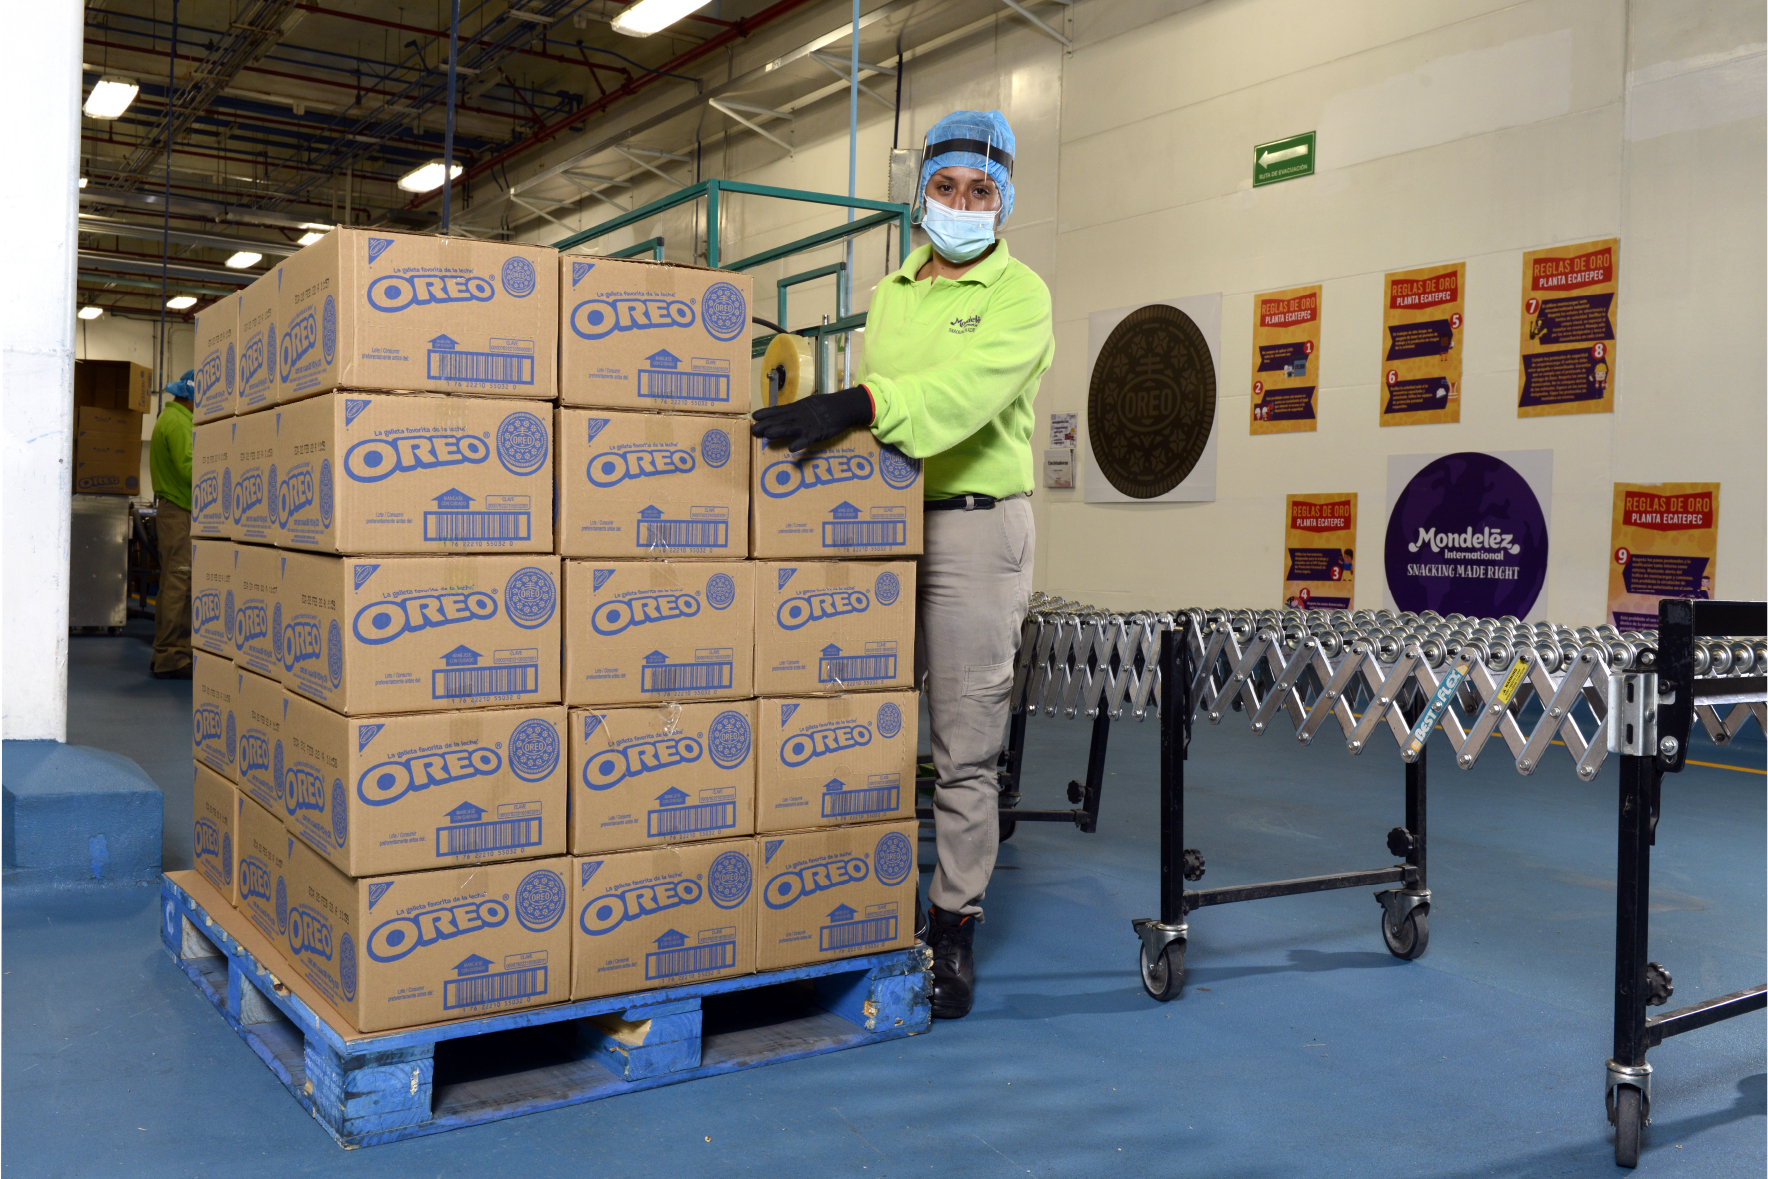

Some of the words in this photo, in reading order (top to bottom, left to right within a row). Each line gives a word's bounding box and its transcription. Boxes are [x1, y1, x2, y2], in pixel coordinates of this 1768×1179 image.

[1534, 260, 1570, 277] REGLAS
[1574, 257, 1587, 271] DE
[1590, 254, 1610, 269] ORO
[1539, 275, 1566, 288] PLANTA
[1568, 270, 1604, 284] ECATEPEC
[367, 275, 495, 313] OREO
[1262, 300, 1288, 315] REGLAS
[1290, 299, 1299, 311] DE
[1302, 297, 1316, 309] ORO
[1392, 282, 1423, 296] REGLAS
[1426, 280, 1436, 292] DE
[1439, 277, 1456, 290] ORO
[1397, 295, 1419, 306] PLANTA
[1421, 292, 1451, 303] ECATEPEC
[571, 299, 695, 340] OREO
[1266, 314, 1284, 324] PLANTA
[1286, 310, 1311, 322] ECATEPEC
[239, 338, 264, 398] OREO
[280, 313, 317, 383] OREO
[194, 356, 221, 408] OREO
[1126, 389, 1172, 418] OREO
[344, 435, 490, 483] OREO
[587, 450, 695, 488] OREO
[761, 455, 874, 498] OREO
[78, 477, 120, 489] OREO
[192, 476, 219, 522] OREO
[233, 474, 263, 525] OREO
[278, 470, 314, 530] OREO
[1293, 506, 1320, 517] REGLAS
[1323, 506, 1332, 517] DE
[1334, 505, 1349, 517] ORO
[1297, 519, 1316, 527] PLANTA
[1318, 518, 1345, 527] ECATEPEC
[1626, 498, 1666, 512] REGLAS
[1670, 498, 1684, 511] DE
[1688, 498, 1710, 512] ORO
[1632, 514, 1661, 523] PLANTA
[1664, 514, 1702, 524] ECATEPEC
[1407, 564, 1455, 577] SNACKING
[1456, 565, 1486, 578] MADE
[1488, 566, 1520, 580] RIGHT
[1445, 549, 1504, 560] International
[192, 594, 220, 634] OREO
[235, 606, 267, 651] OREO
[353, 592, 498, 645] OREO
[592, 594, 700, 636] OREO
[777, 591, 870, 630] OREO
[283, 622, 321, 672] OREO
[194, 709, 222, 747] OREO
[780, 725, 872, 767] OREO
[1415, 709, 1437, 742] BEST
[239, 734, 269, 777] OREO
[583, 737, 703, 791] OREO
[285, 768, 325, 816] OREO
[357, 747, 502, 806] OREO
[194, 821, 219, 859] OREO
[239, 859, 271, 902] OREO
[532, 893, 550, 901] OREO
[764, 858, 869, 909] OREO
[580, 879, 702, 936] OREO
[288, 907, 333, 961] OREO
[367, 900, 509, 963] OREO
